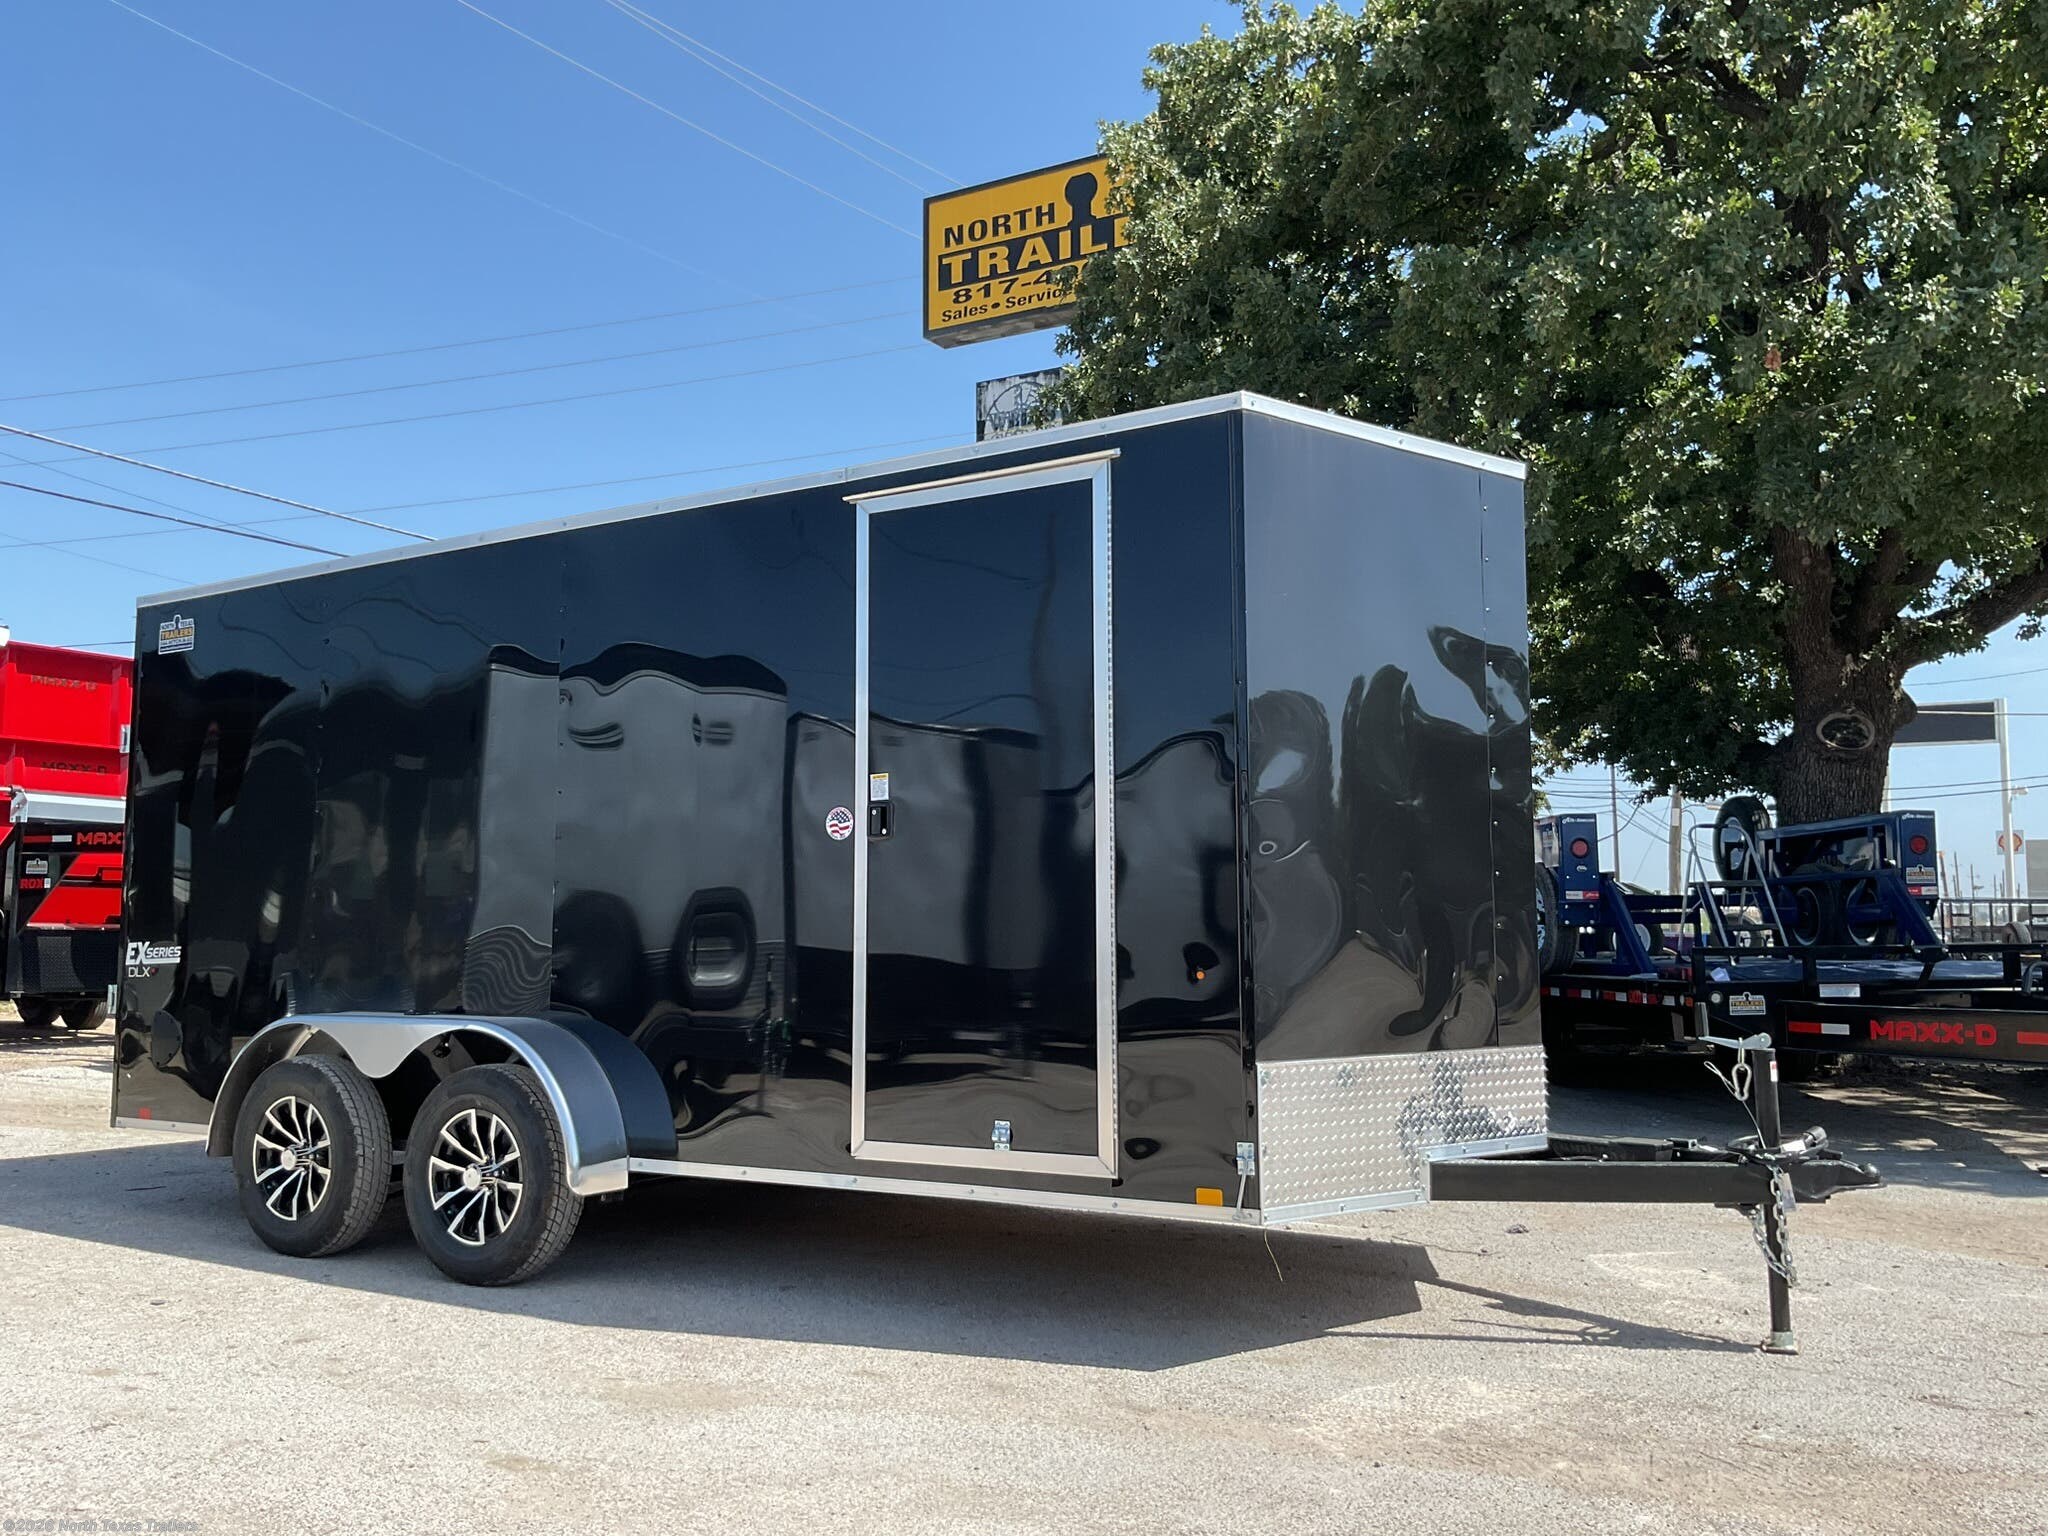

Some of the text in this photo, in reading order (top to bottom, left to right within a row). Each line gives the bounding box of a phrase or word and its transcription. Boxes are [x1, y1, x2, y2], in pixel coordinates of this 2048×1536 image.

[944, 202, 1055, 248] NORTH
[942, 303, 988, 322] Sales
[160, 626, 193, 640] TRAILERS
[76, 831, 124, 846] MAX
[128, 966, 150, 978] DLX
[1869, 1019, 1998, 1046] MAXX-D
